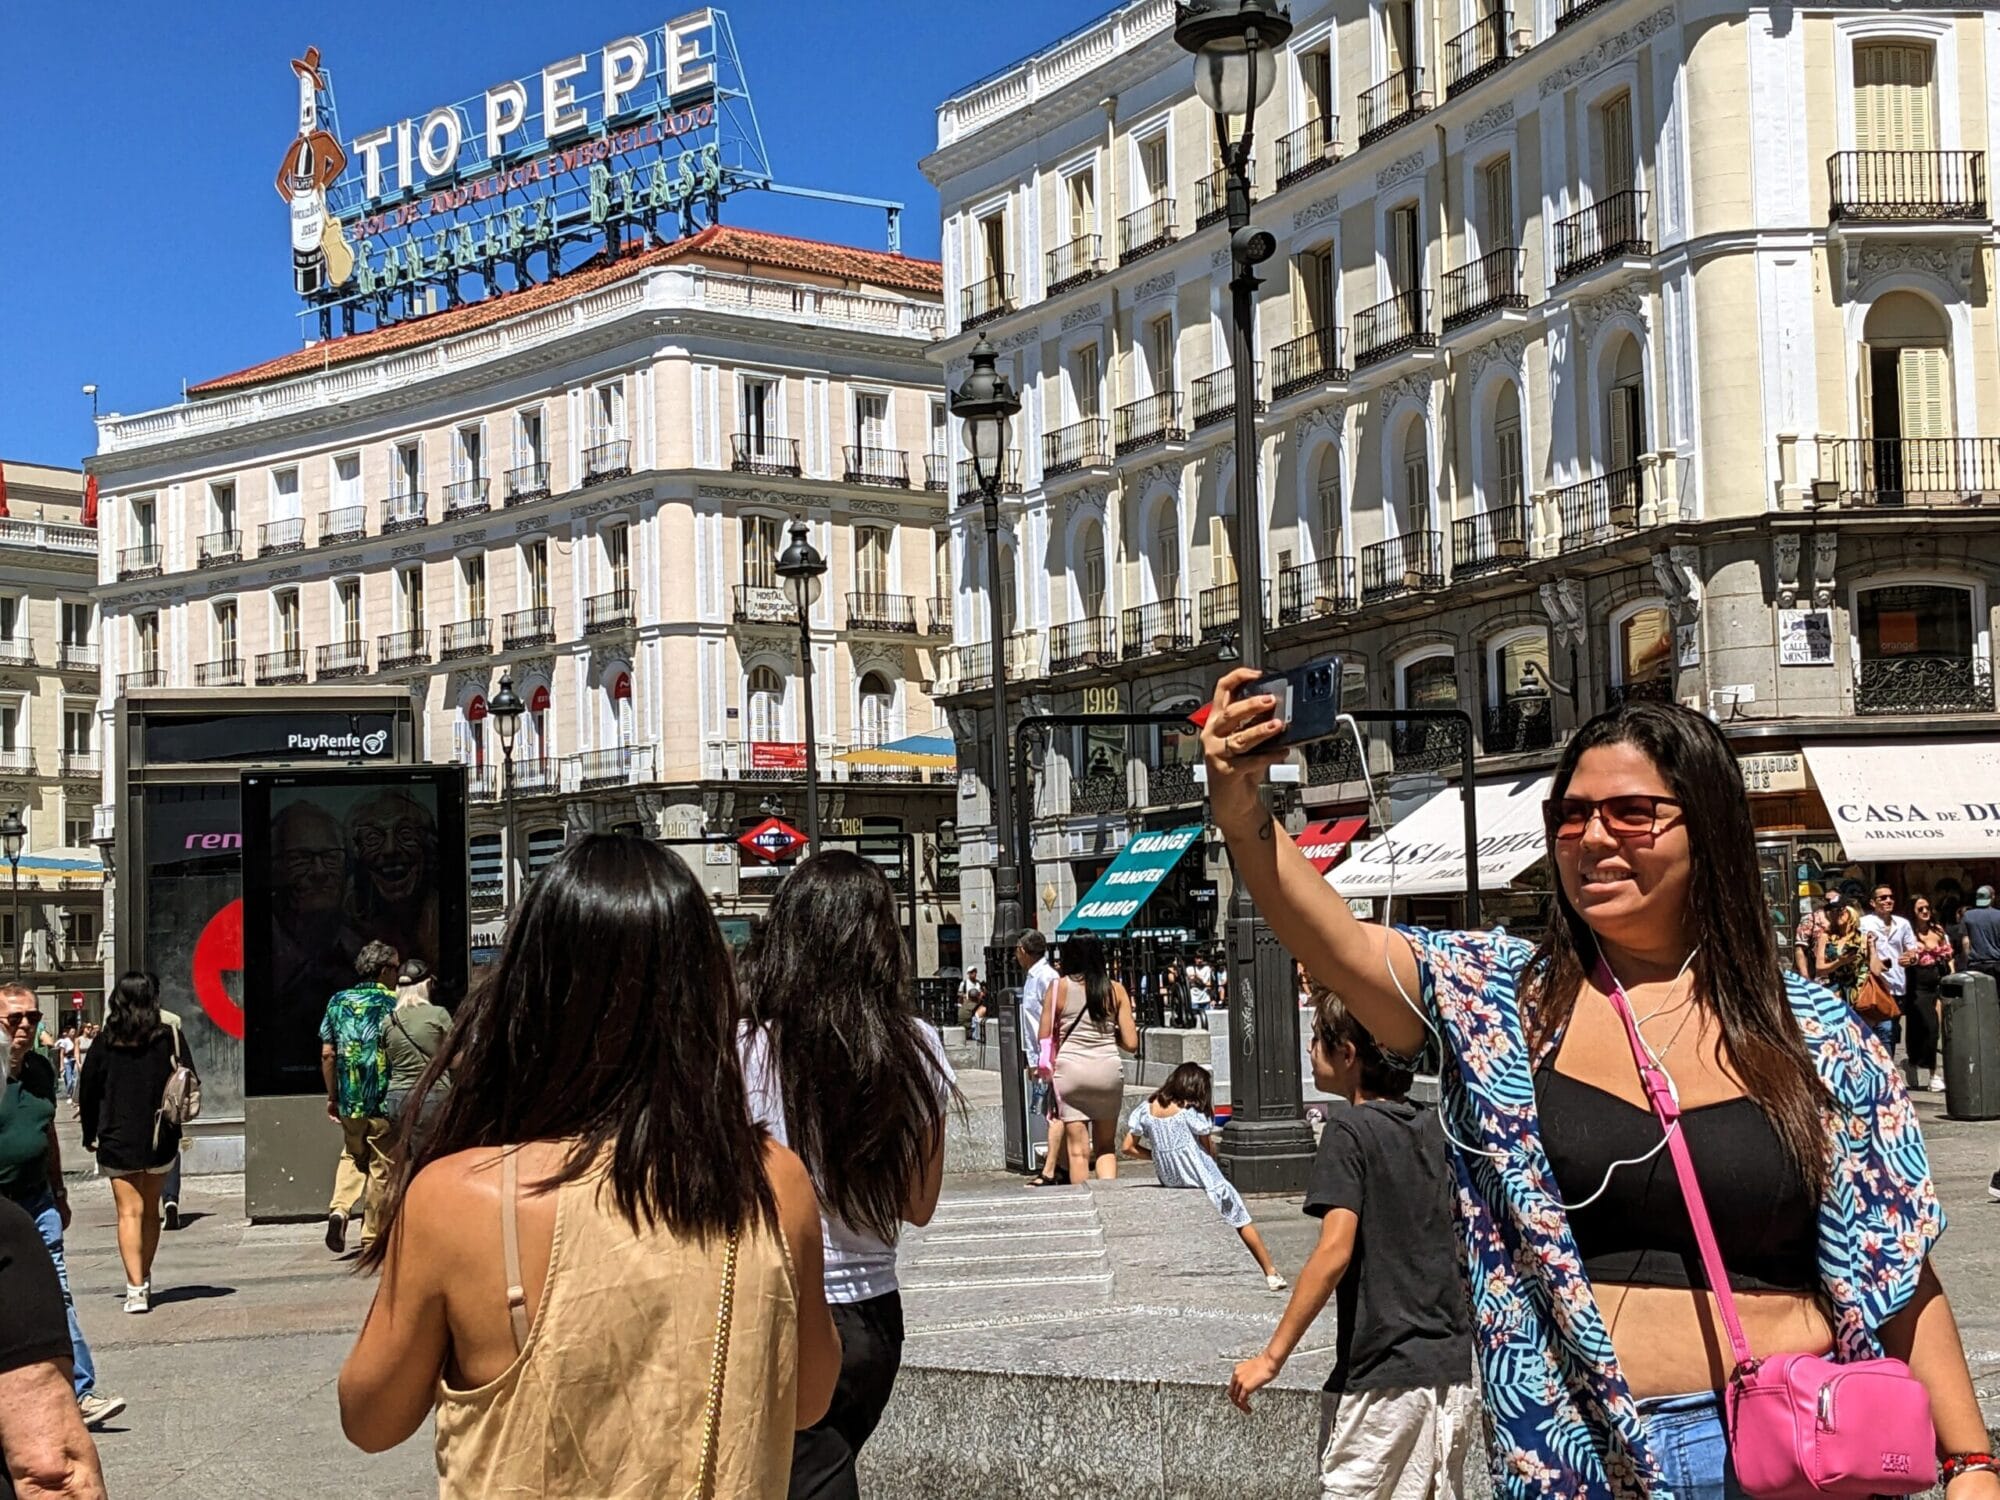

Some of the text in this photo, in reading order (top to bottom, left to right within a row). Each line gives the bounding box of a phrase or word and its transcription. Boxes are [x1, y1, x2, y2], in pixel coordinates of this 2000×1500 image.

[353, 7, 713, 199] TIO PEPE
[352, 211, 390, 240] SOL
[396, 202, 421, 226] DE
[430, 160, 540, 215] ANDALUCIA
[546, 103, 714, 176] EMBOTELLADO
[589, 142, 720, 225] BYASS
[756, 591, 783, 601] HOSTAL
[1783, 643, 1809, 651] CALLE
[1881, 642, 1915, 651] orange
[1784, 651, 1832, 662] MONTERA
[1083, 687, 1119, 714] 1919
[287, 733, 360, 751] PlayRenfe
[1837, 803, 1930, 823] CASA
[1936, 812, 1961, 821] DE
[759, 834, 790, 845] Metro
[1130, 832, 1193, 854] CHANGE
[1864, 829, 1945, 839] ABANICOS
[1360, 840, 1446, 865] CASA
[1105, 868, 1165, 886] TRANSFER
[1077, 899, 1139, 919] CAMBIO
